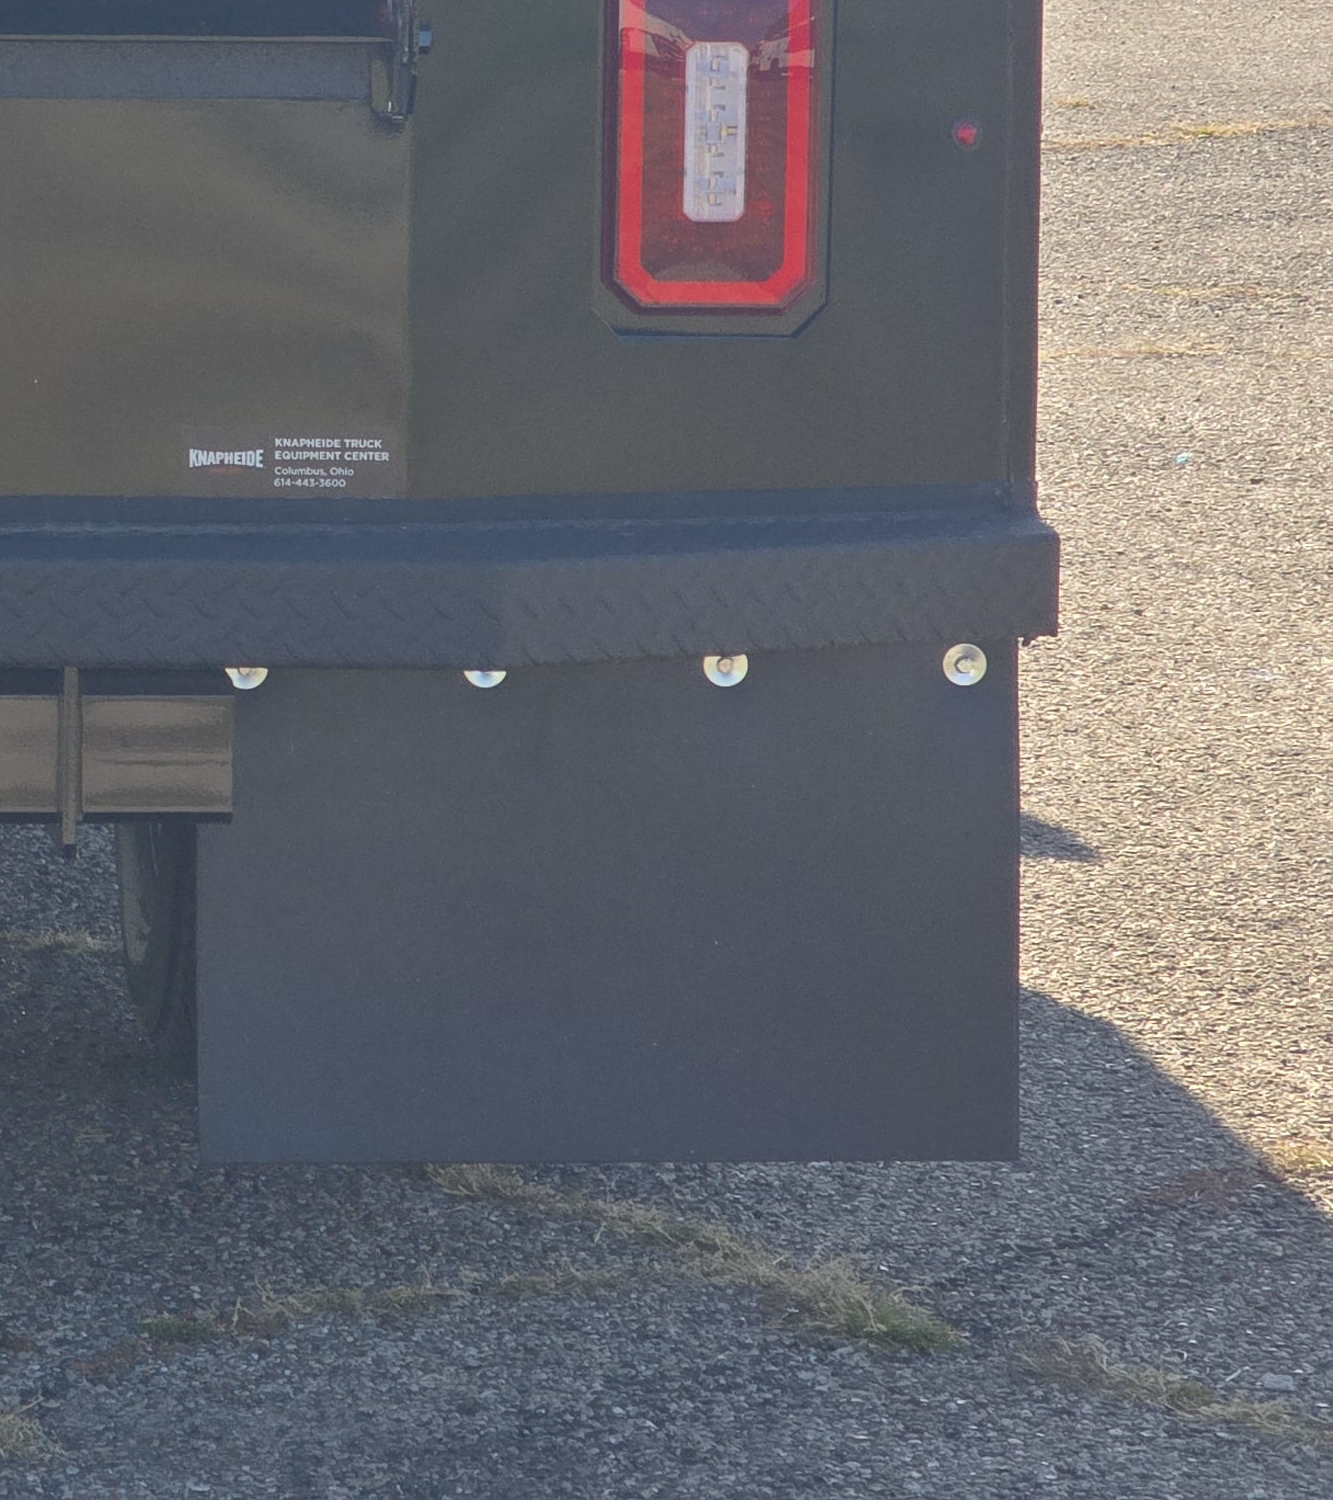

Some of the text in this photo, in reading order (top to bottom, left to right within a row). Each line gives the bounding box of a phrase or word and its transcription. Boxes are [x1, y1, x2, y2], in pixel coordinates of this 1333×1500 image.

[274, 438, 382, 448] KNAPHEIDE TRUCK
[189, 448, 264, 468] KNAPHEIDE
[274, 451, 390, 461] EQUIPMENT CENTER
[274, 466, 354, 476] Columbus, Ohio
[274, 478, 346, 488] 614-443-3600
